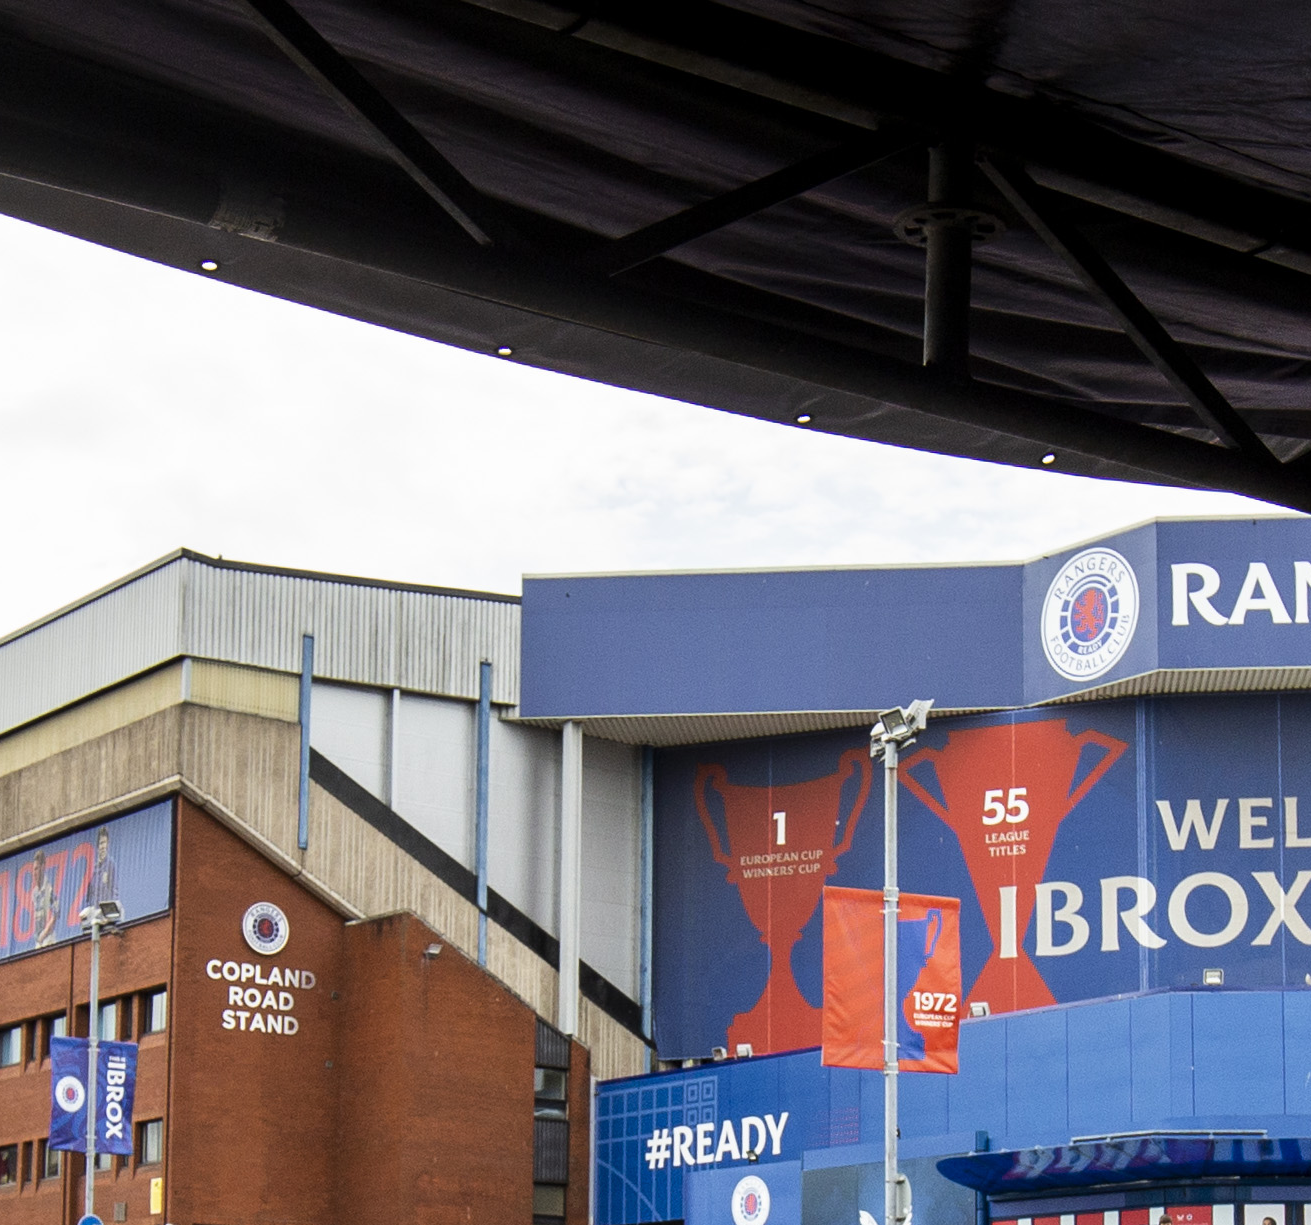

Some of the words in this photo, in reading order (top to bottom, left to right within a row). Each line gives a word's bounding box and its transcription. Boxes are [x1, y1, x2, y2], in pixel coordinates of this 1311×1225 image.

[1054, 557, 1125, 600] RANGERS
[1050, 635, 1106, 671] FOOTBALL
[1107, 614, 1130, 654] CLUB
[982, 787, 1030, 826] 55
[772, 811, 787, 846] 1
[985, 829, 1030, 844] LEAGUE
[740, 852, 799, 866] EUROPEAN
[801, 849, 824, 861] CUP
[988, 844, 1027, 858] TITLES
[798, 863, 821, 875] CUP
[206, 958, 317, 990] COPLAND
[228, 985, 295, 1012] ROAD
[913, 991, 958, 1013] 1972
[221, 1008, 300, 1036] STAND
[105, 1062, 127, 1140] IBROX
[645, 1111, 789, 1170] #READY
